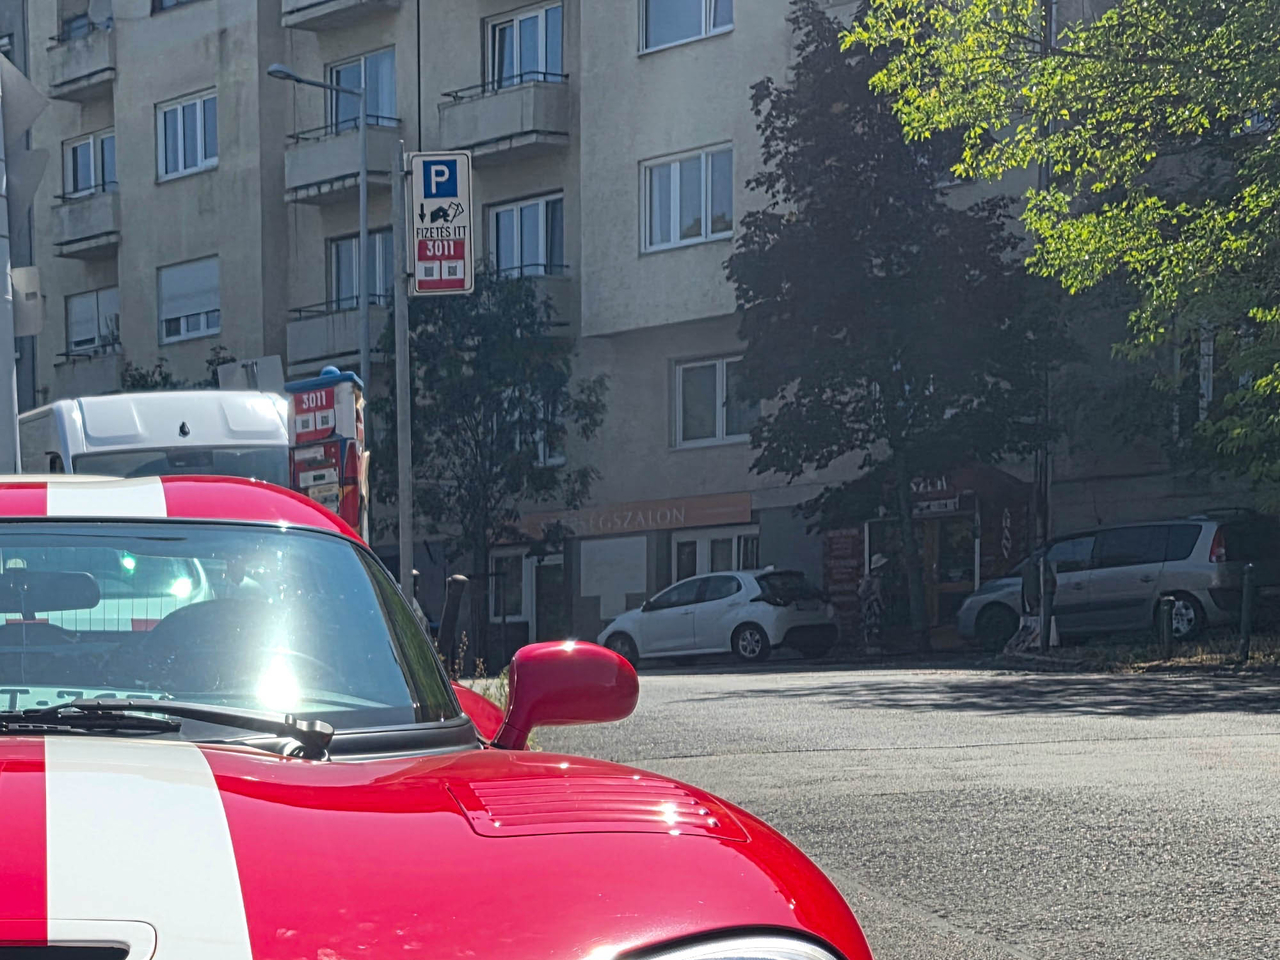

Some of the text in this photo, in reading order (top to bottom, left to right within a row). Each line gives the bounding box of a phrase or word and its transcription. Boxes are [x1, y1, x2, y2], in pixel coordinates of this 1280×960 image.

[431, 165, 450, 194] P
[416, 224, 467, 239] FIZETÉS ITT
[426, 240, 455, 256] 3011
[302, 390, 326, 409] 3011
